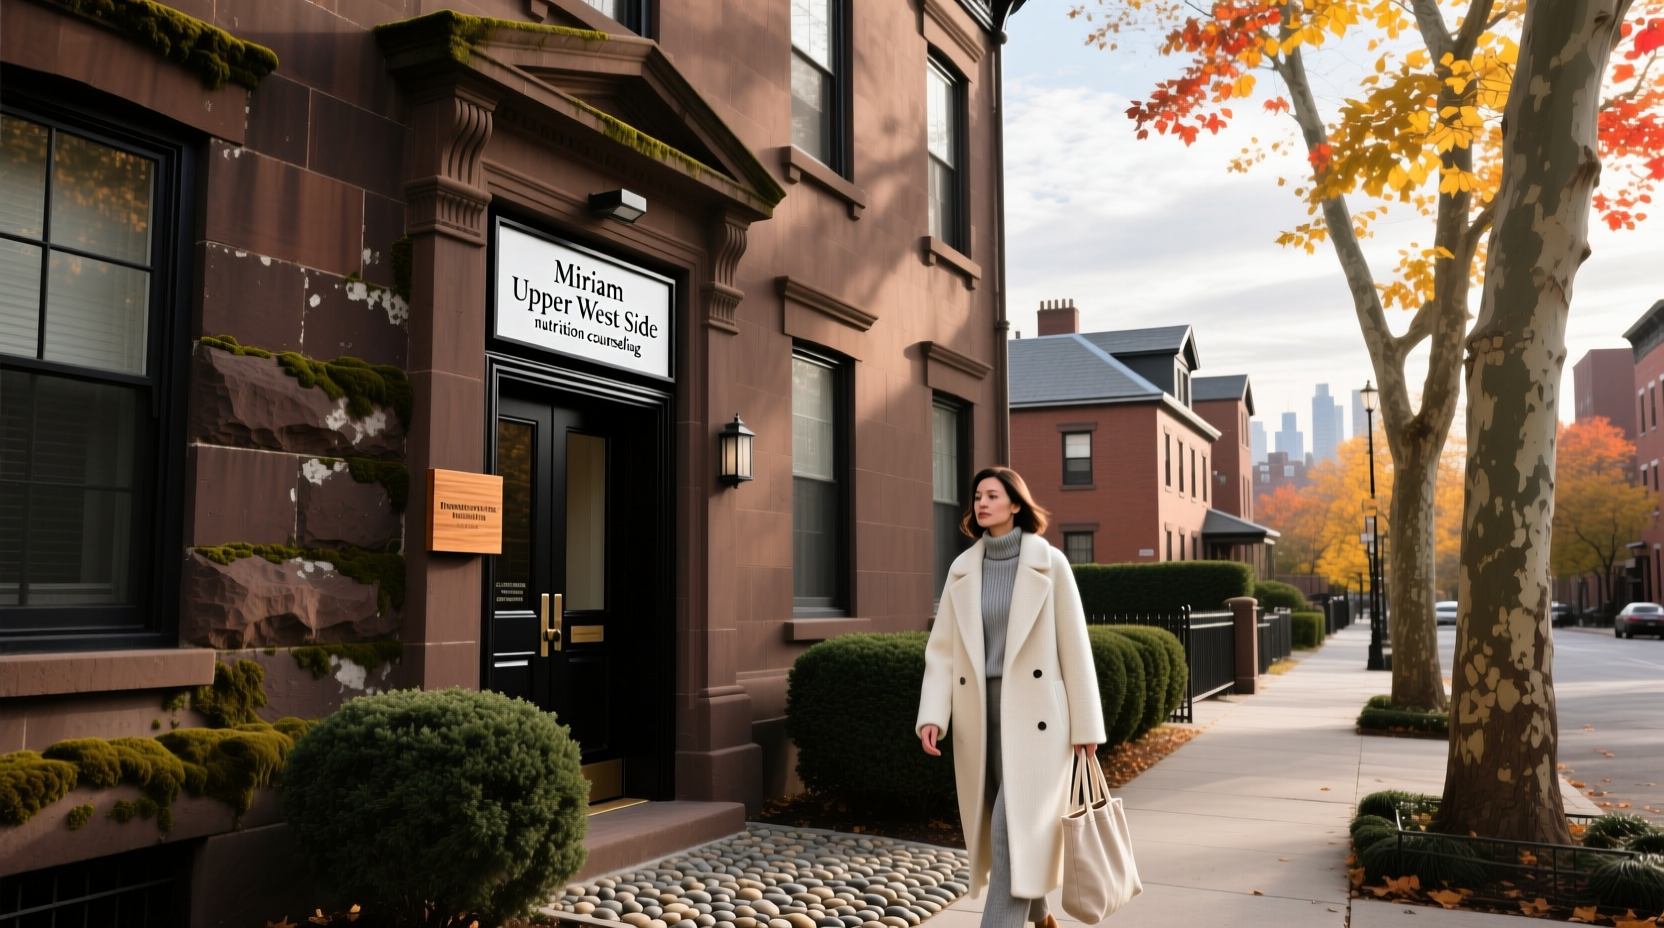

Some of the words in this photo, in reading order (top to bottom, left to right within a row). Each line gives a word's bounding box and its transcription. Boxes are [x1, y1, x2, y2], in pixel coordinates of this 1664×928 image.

[554, 260, 624, 302] Miriam
[512, 276, 573, 315] Upper
[576, 296, 620, 328] West
[624, 311, 658, 338] Side
[535, 318, 584, 339] nutrition
